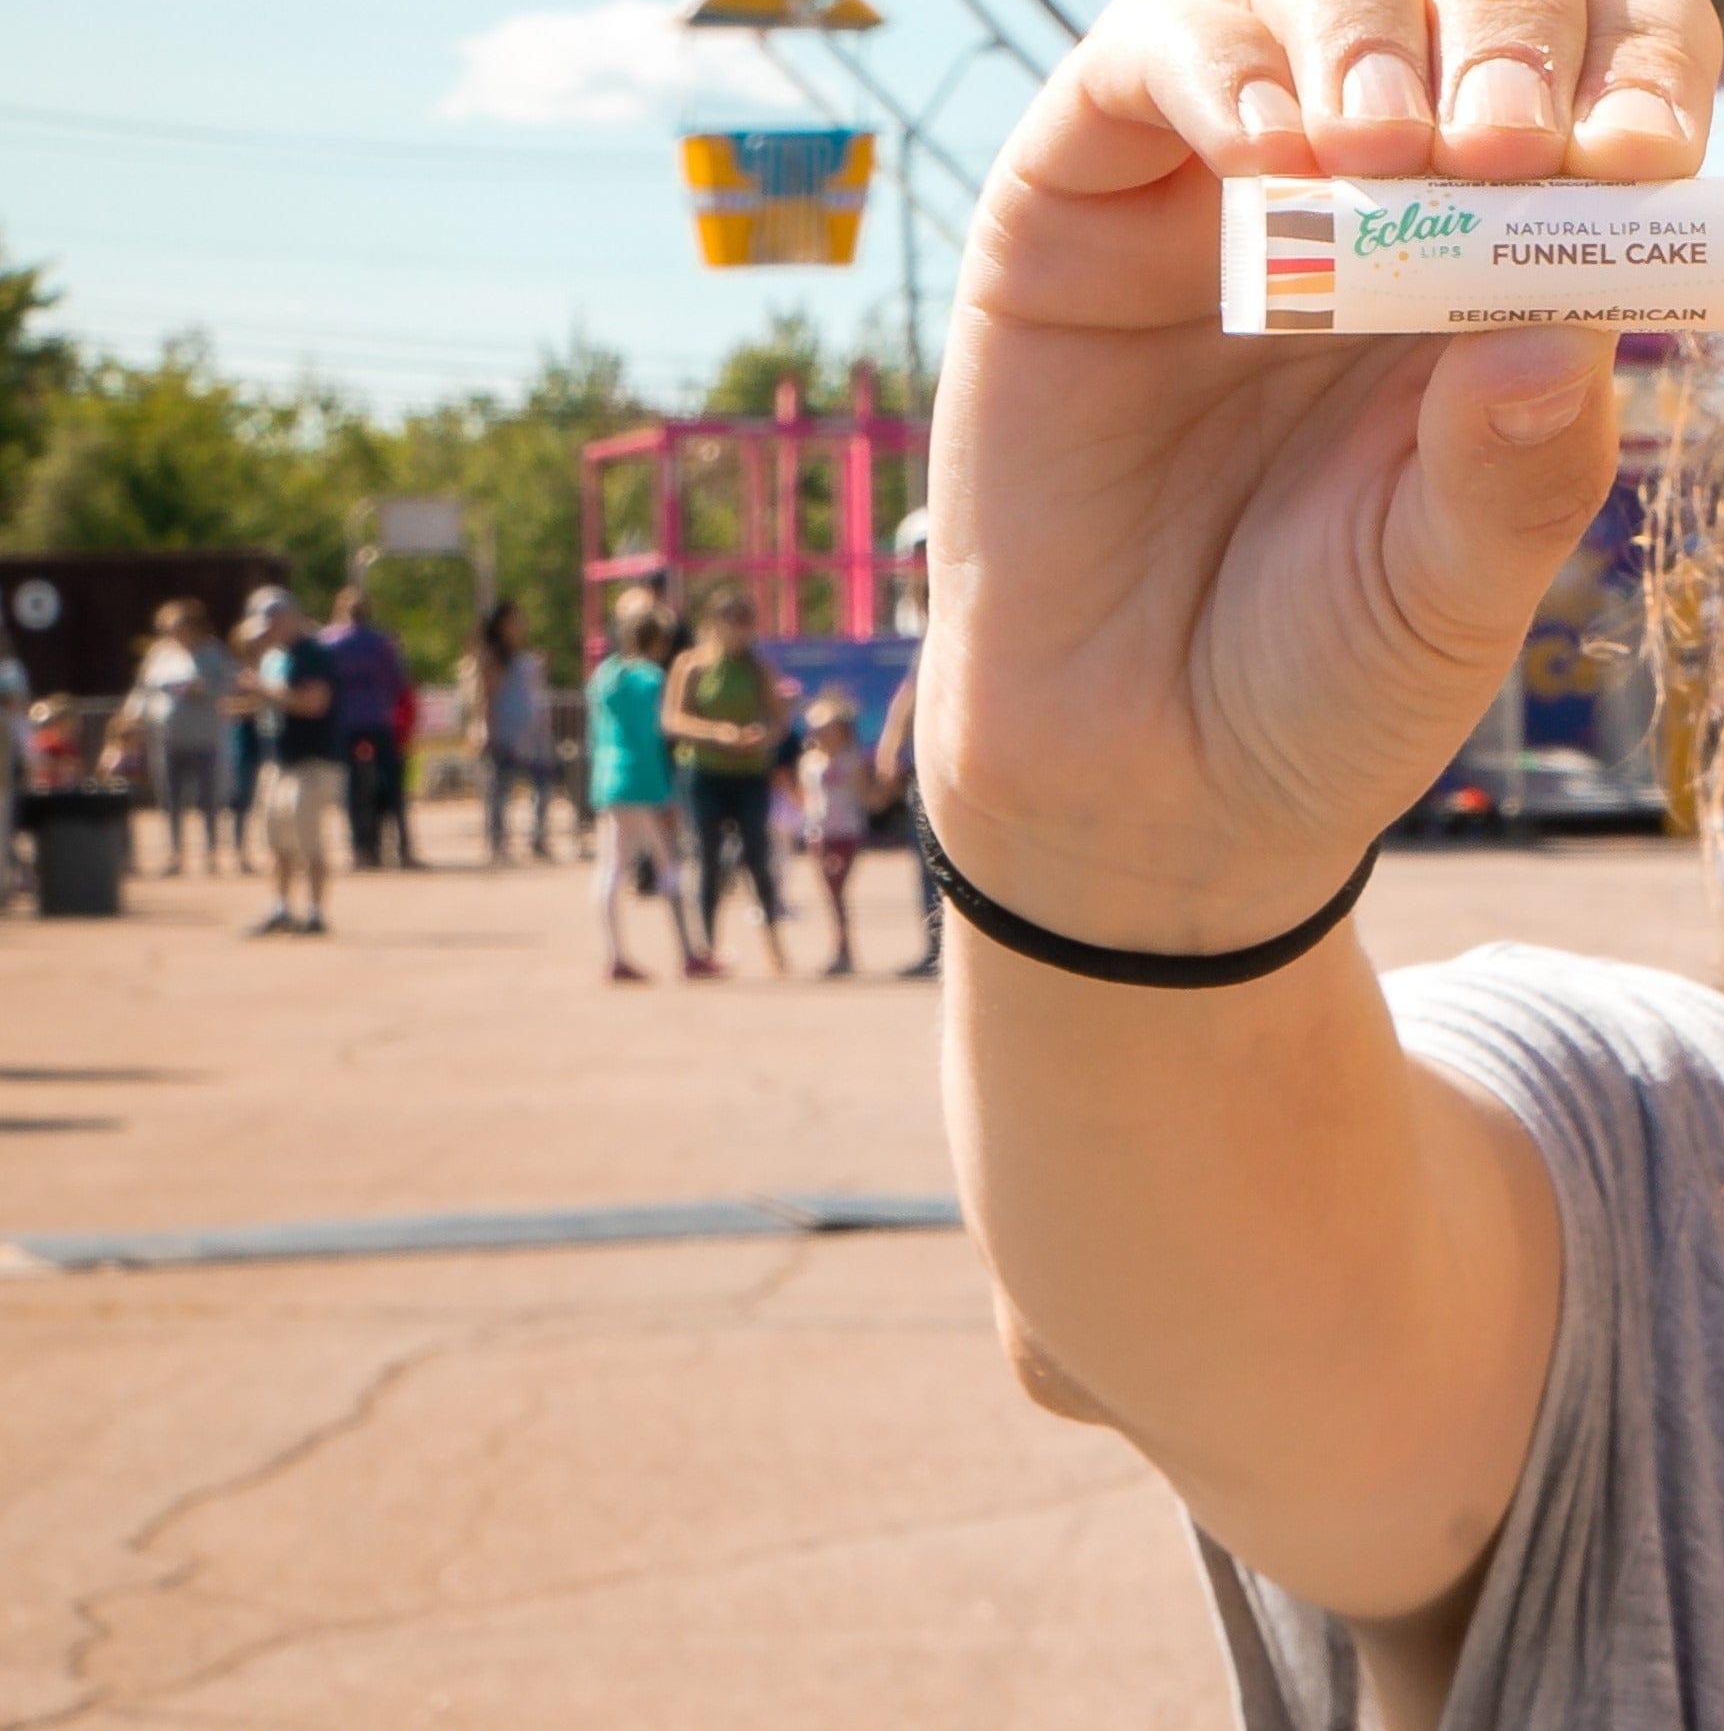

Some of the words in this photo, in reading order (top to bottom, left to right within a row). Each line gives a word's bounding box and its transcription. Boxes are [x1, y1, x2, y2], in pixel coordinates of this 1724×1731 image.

[1505, 221, 1601, 236] NATURAL
[1609, 221, 1641, 235] LIP
[1649, 221, 1707, 235] BALM
[1419, 245, 1462, 259] LIPS
[1492, 242, 1617, 265] FUNNEL
[1625, 242, 1708, 264] CAKE
[1449, 309, 1559, 322] BEIGNET
[1562, 306, 1708, 321] AMÉRICAIN
